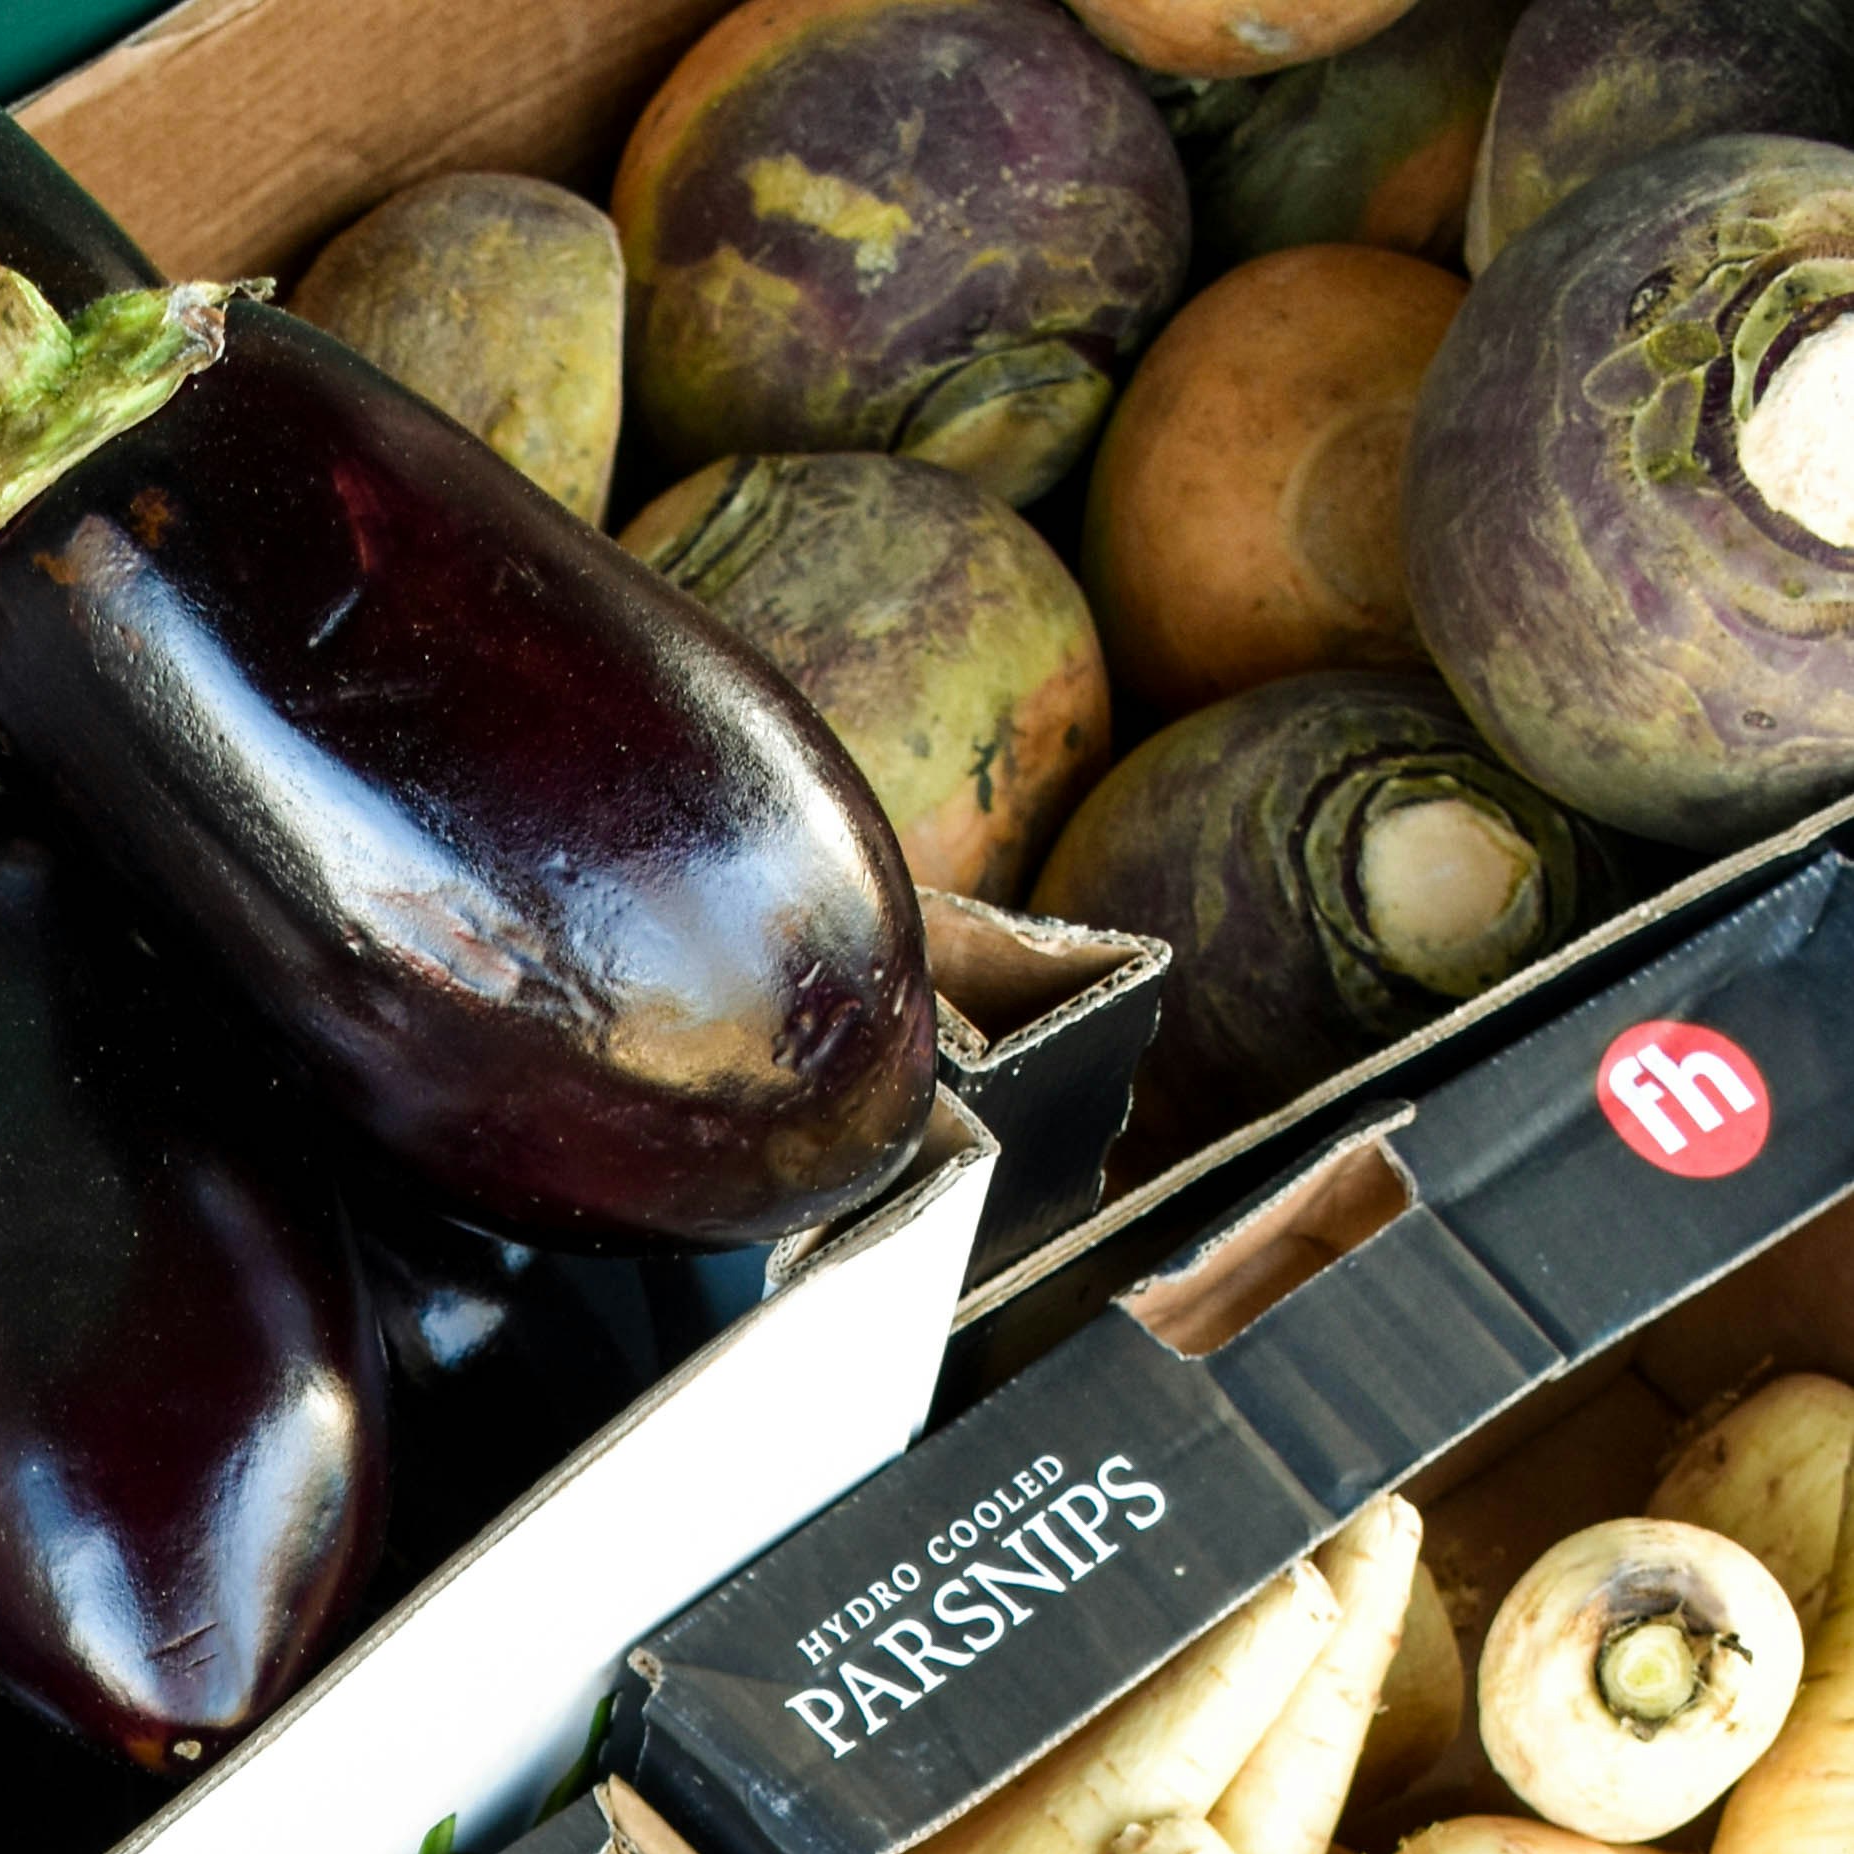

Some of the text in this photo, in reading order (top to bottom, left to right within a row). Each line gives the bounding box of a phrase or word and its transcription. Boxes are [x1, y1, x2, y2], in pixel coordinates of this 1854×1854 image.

[1608, 1043, 1756, 1155] fh
[784, 1454, 1166, 1759] PARSNIPS
[796, 1454, 1064, 1666] HYDRO COOLED
